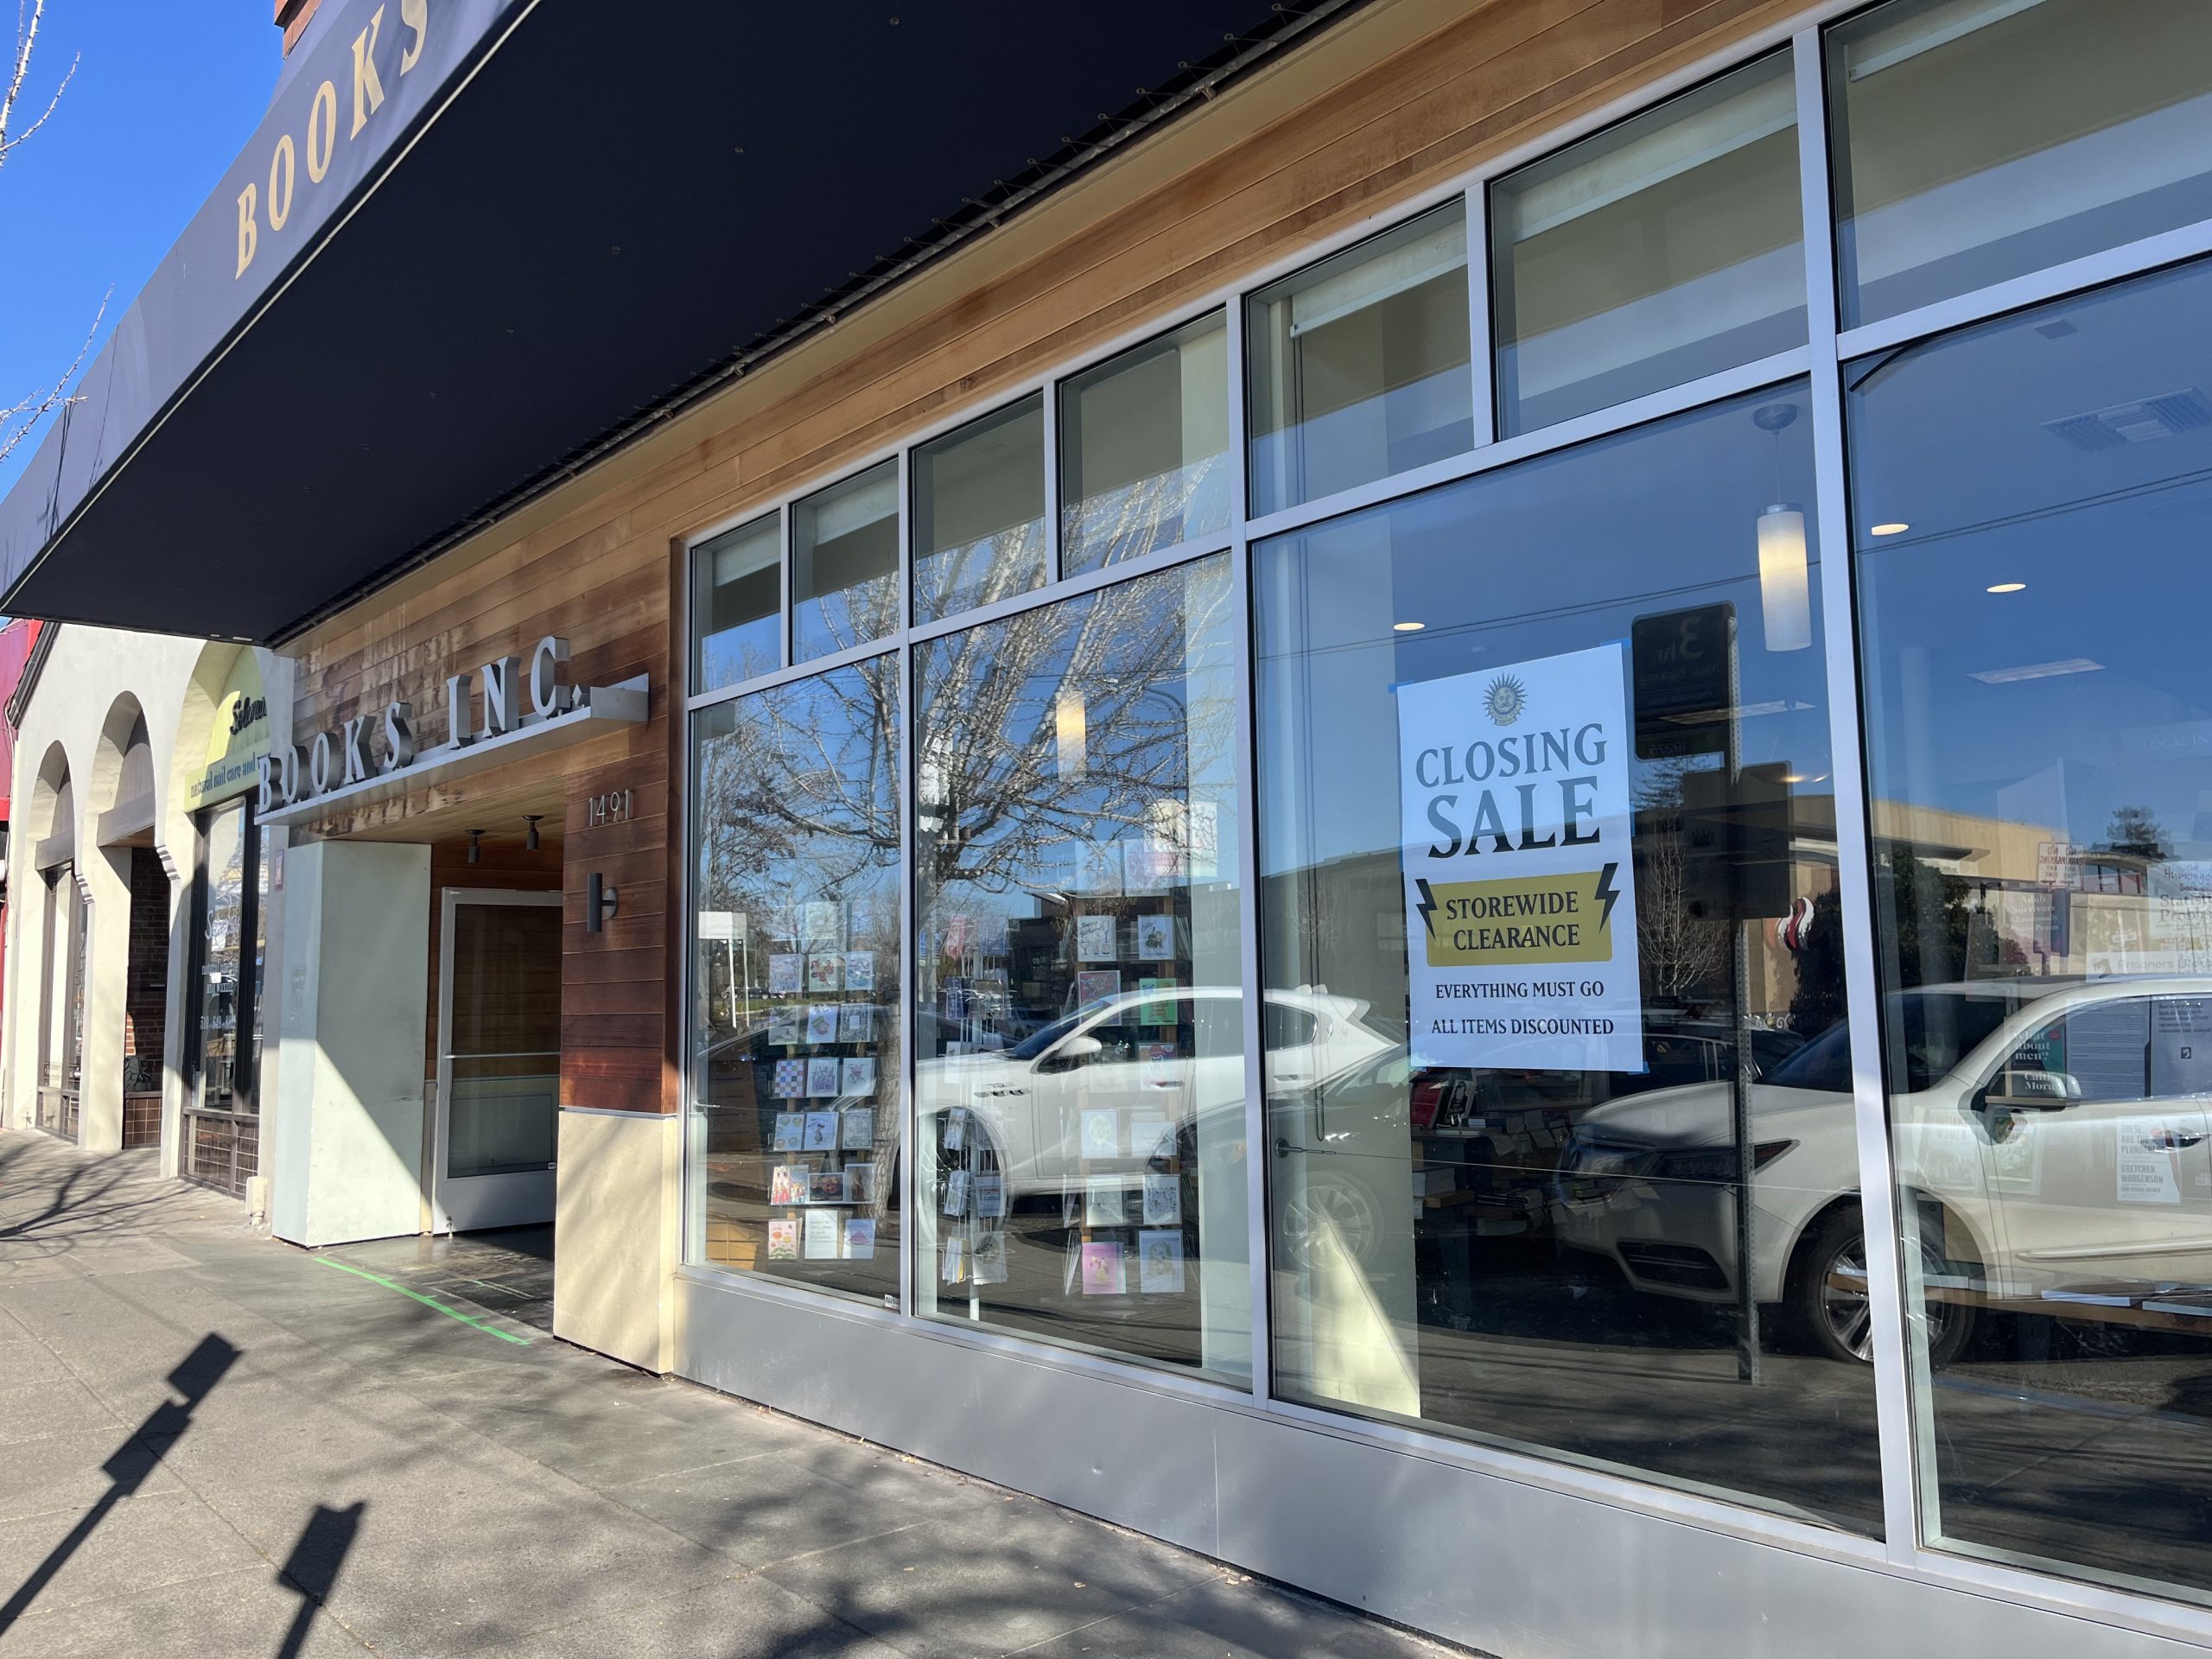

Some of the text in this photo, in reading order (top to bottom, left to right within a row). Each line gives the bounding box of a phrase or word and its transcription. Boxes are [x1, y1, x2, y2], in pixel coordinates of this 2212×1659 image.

[258, 635, 589, 814] BOOKS INC.
[1415, 722, 1607, 788] CLOSING
[190, 771, 213, 798] natural
[213, 765, 226, 787] nail
[226, 766, 242, 782] care
[242, 752, 256, 776] and
[588, 789, 632, 827] 1491
[1427, 775, 1601, 859] SALE
[1446, 890, 1580, 921] STOREWIDE
[1452, 923, 1581, 951] CLEARANCE
[1434, 980, 1605, 1000] EVERYTHING MUST GO
[1431, 1018, 1615, 1036] ALL ITEMS DISCOUNTED
